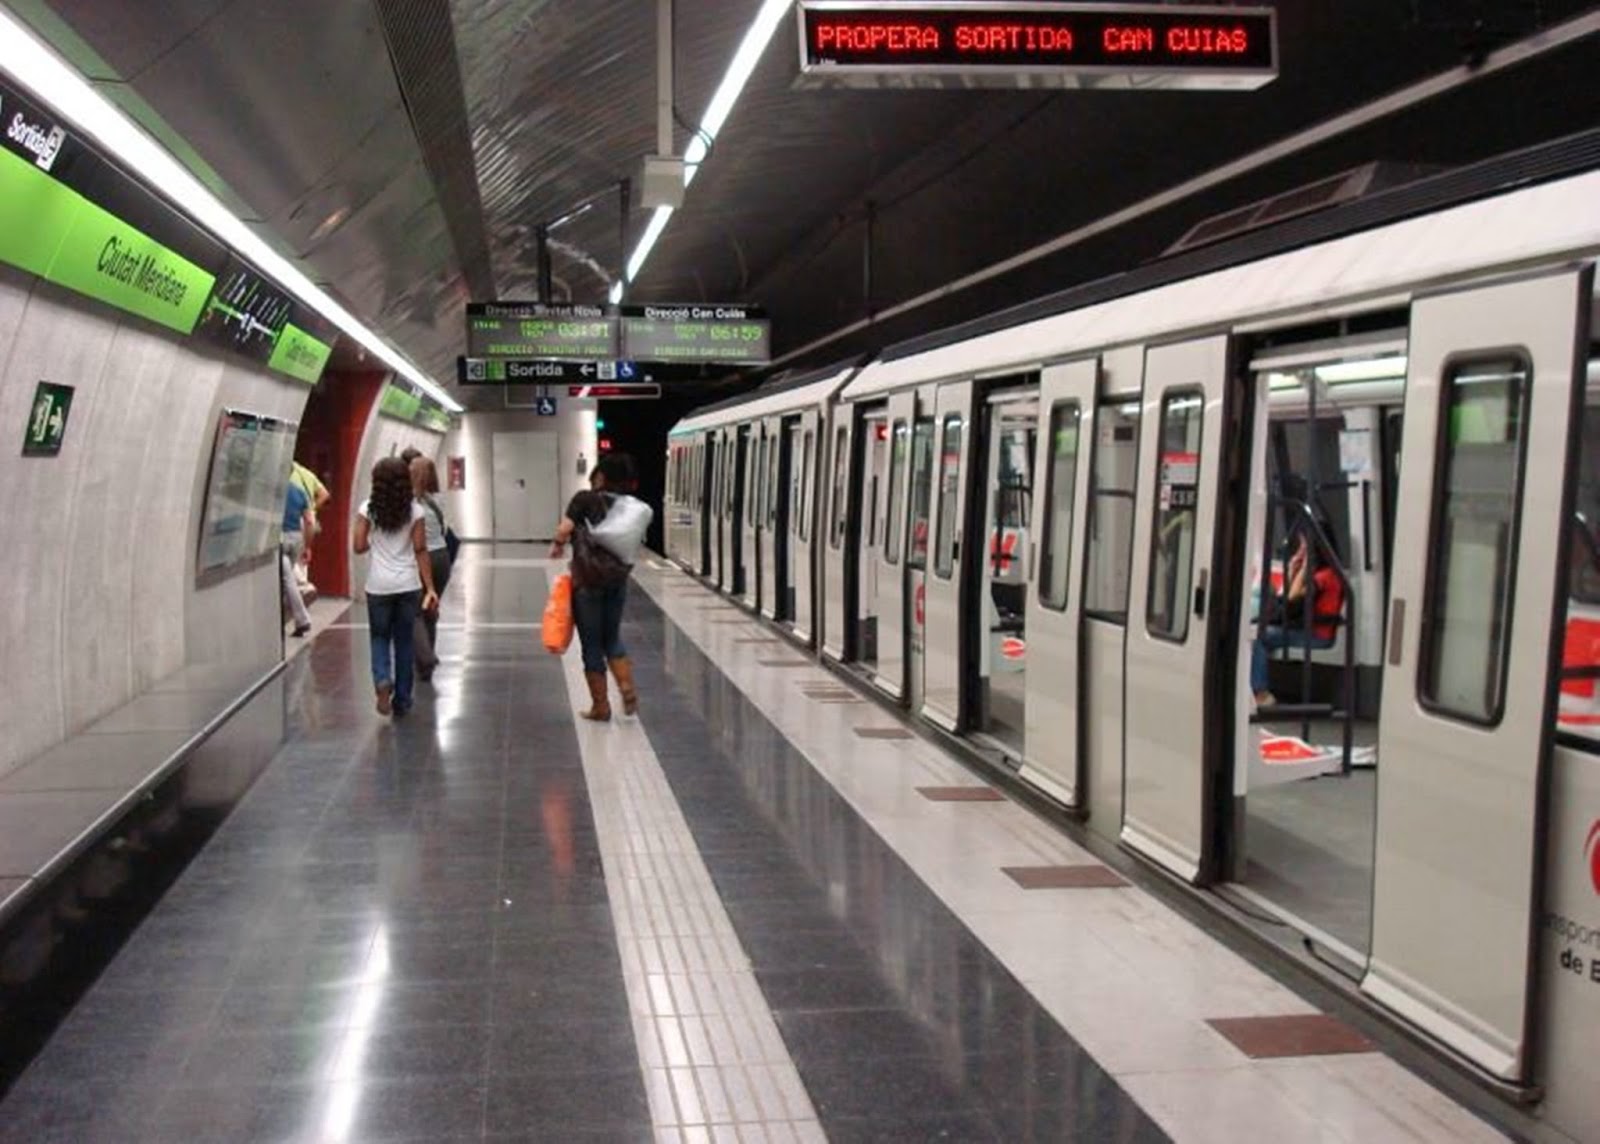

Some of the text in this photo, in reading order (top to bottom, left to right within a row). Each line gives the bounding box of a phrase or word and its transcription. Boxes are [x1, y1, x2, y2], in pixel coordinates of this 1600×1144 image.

[817, 26, 1248, 54] PROPERA SORTIDA CAN CUIAS
[7, 112, 48, 155] Sortida
[97, 236, 142, 286] Ciutat
[691, 308, 714, 319] Can
[509, 363, 563, 377] Sortida
[1560, 948, 1583, 976] de
